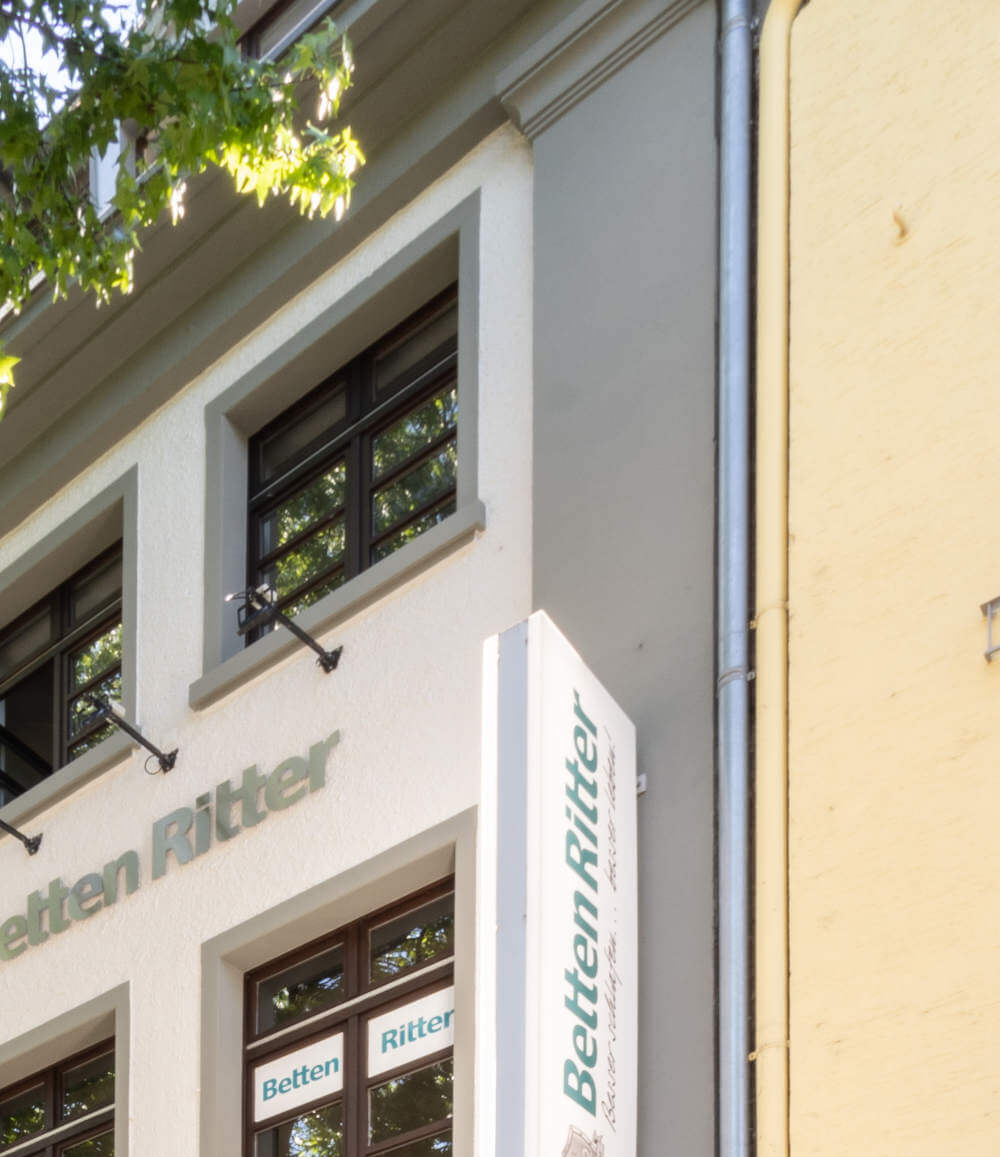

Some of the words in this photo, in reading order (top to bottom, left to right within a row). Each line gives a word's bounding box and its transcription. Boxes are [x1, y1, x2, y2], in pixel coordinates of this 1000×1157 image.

[151, 729, 341, 881] Ritter
[565, 688, 599, 894] Ritter
[262, 1056, 340, 1102] Betten
[381, 1008, 455, 1054] Ritter
[563, 889, 599, 1118] Betten
